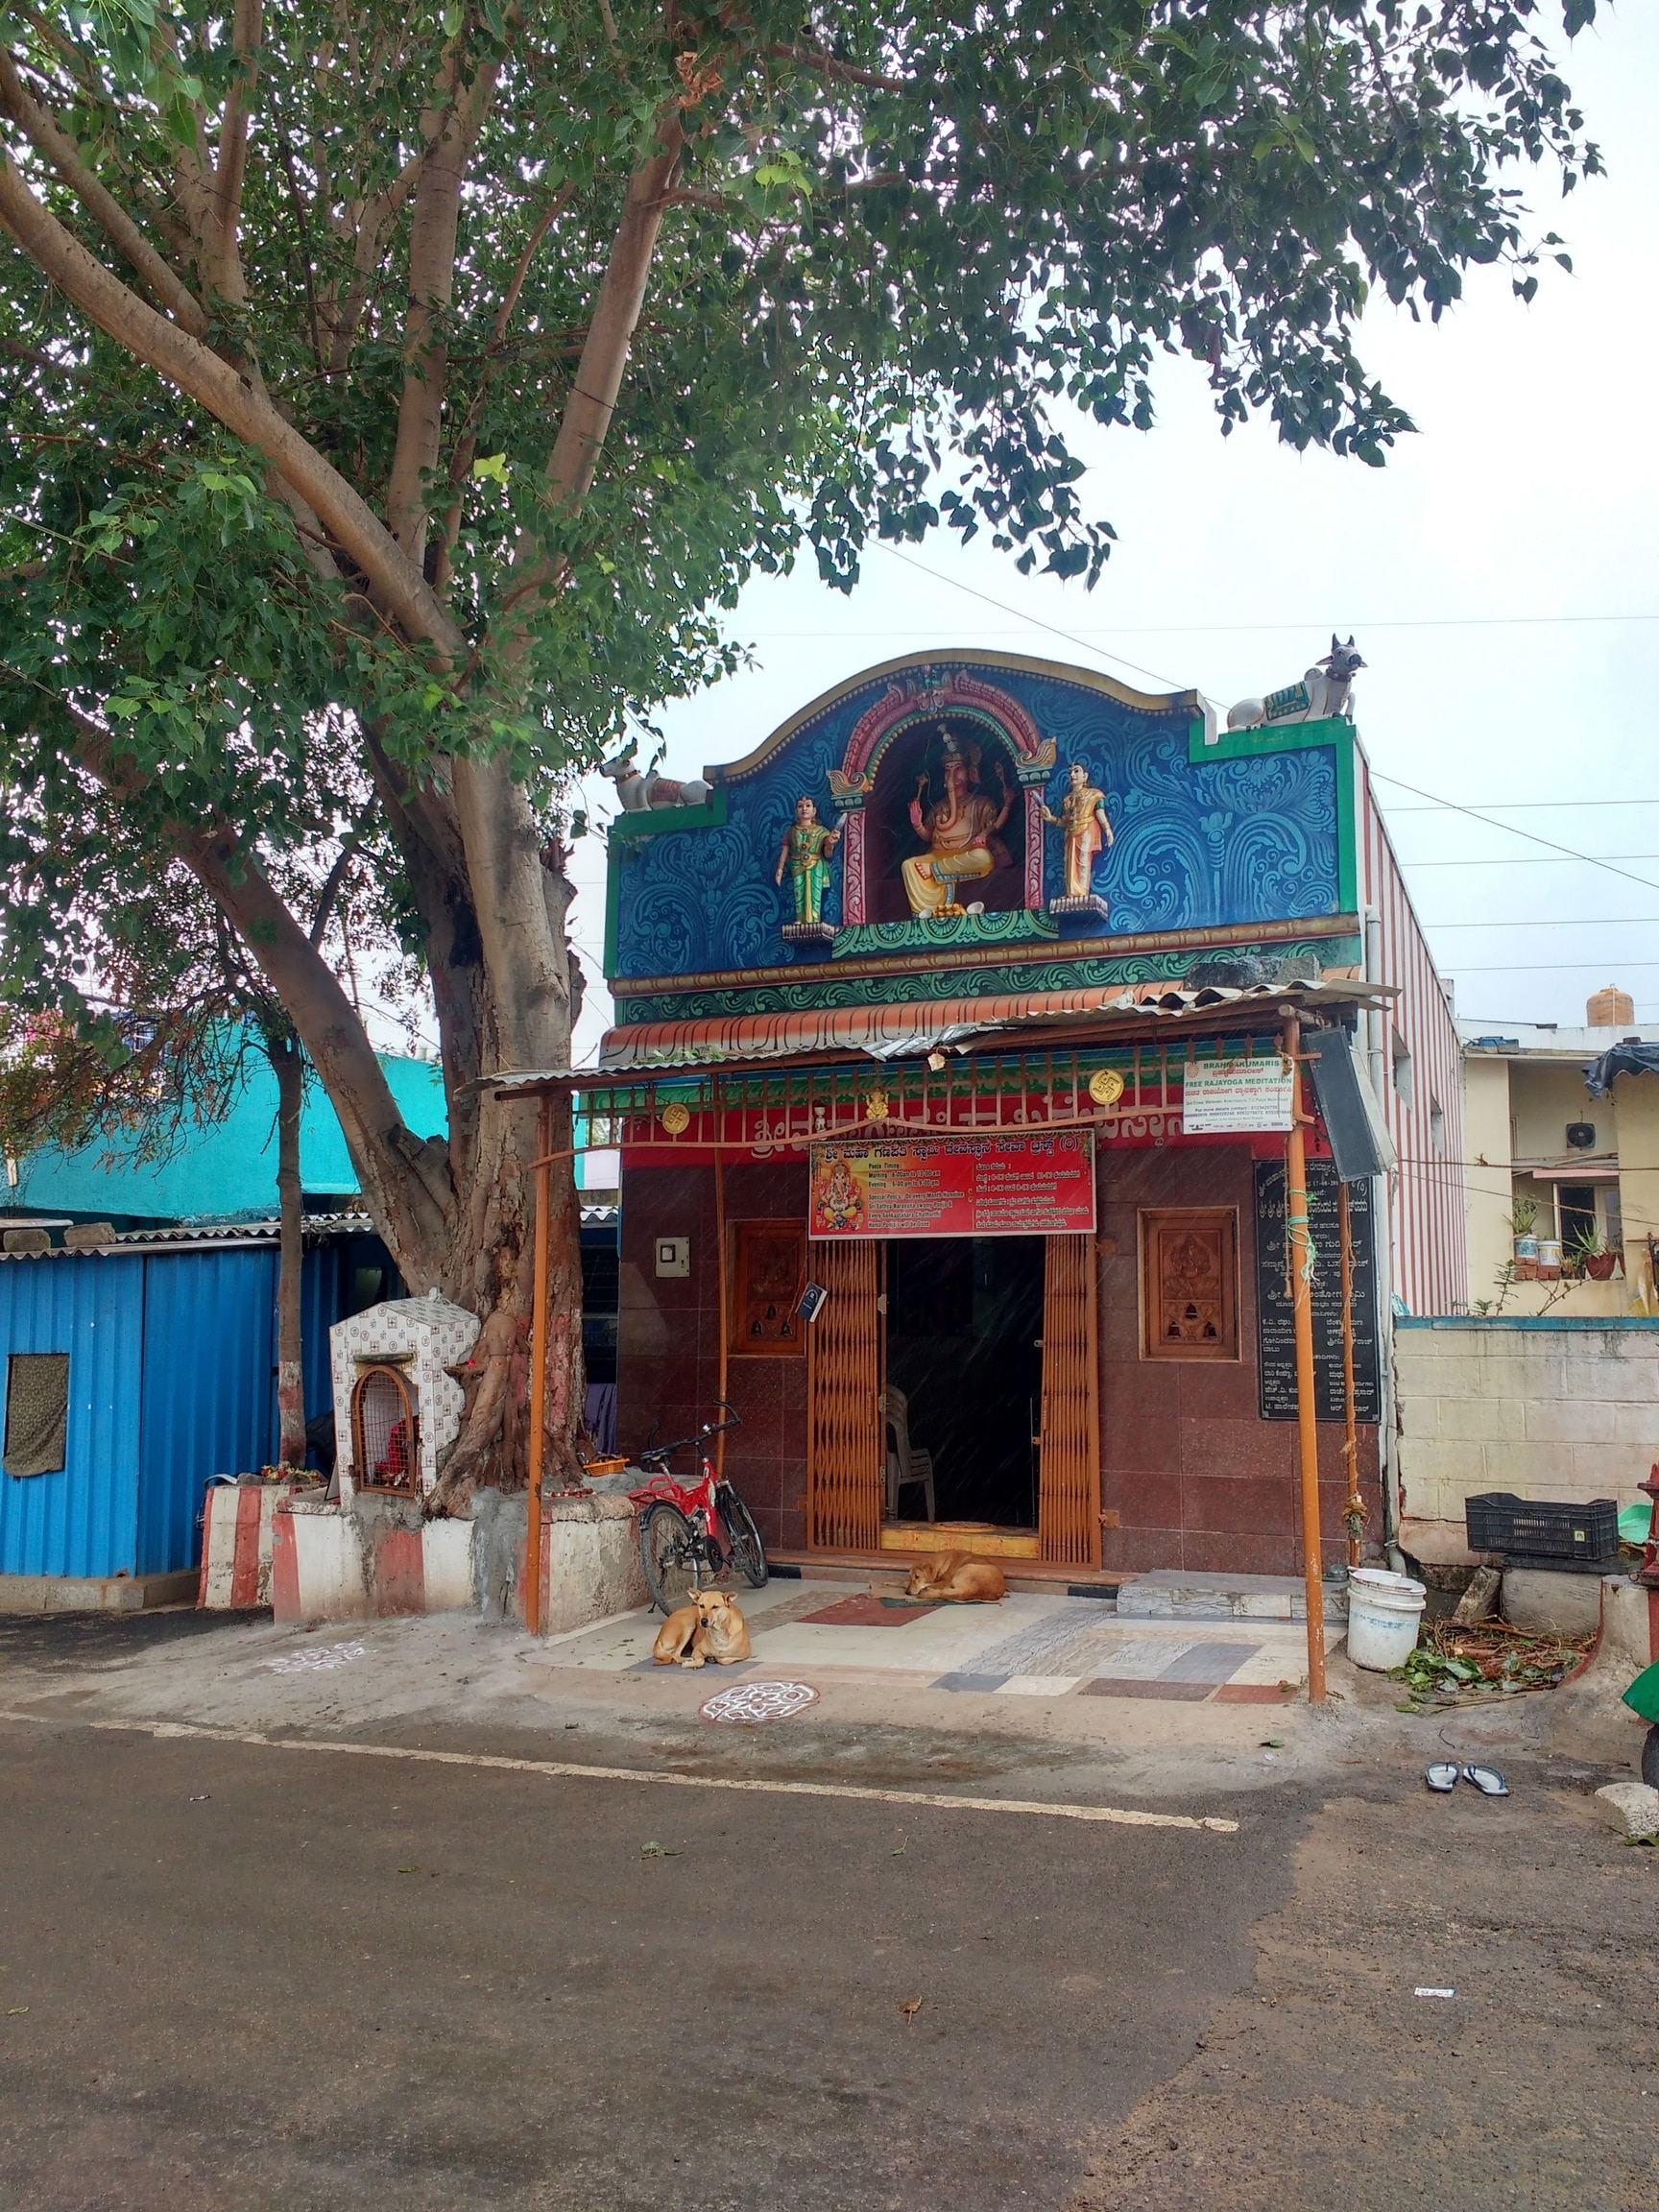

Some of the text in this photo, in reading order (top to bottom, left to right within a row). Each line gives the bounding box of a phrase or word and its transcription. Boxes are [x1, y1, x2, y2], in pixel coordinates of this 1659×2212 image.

[824, 1147, 838, 1163] ಶ್ರೀ
[843, 1148, 869, 1159] ಮಹಾ
[874, 1145, 907, 1158] ಗಣಪತಿ
[912, 1143, 940, 1162] ಸ್ವಾಮಿ
[945, 1142, 991, 1160] ದೇವಸ್ಥಾನ
[996, 1140, 1025, 1153] ಸೇವಾ
[883, 1162, 901, 1170] Timing
[933, 1200, 948, 1210] Pooja
